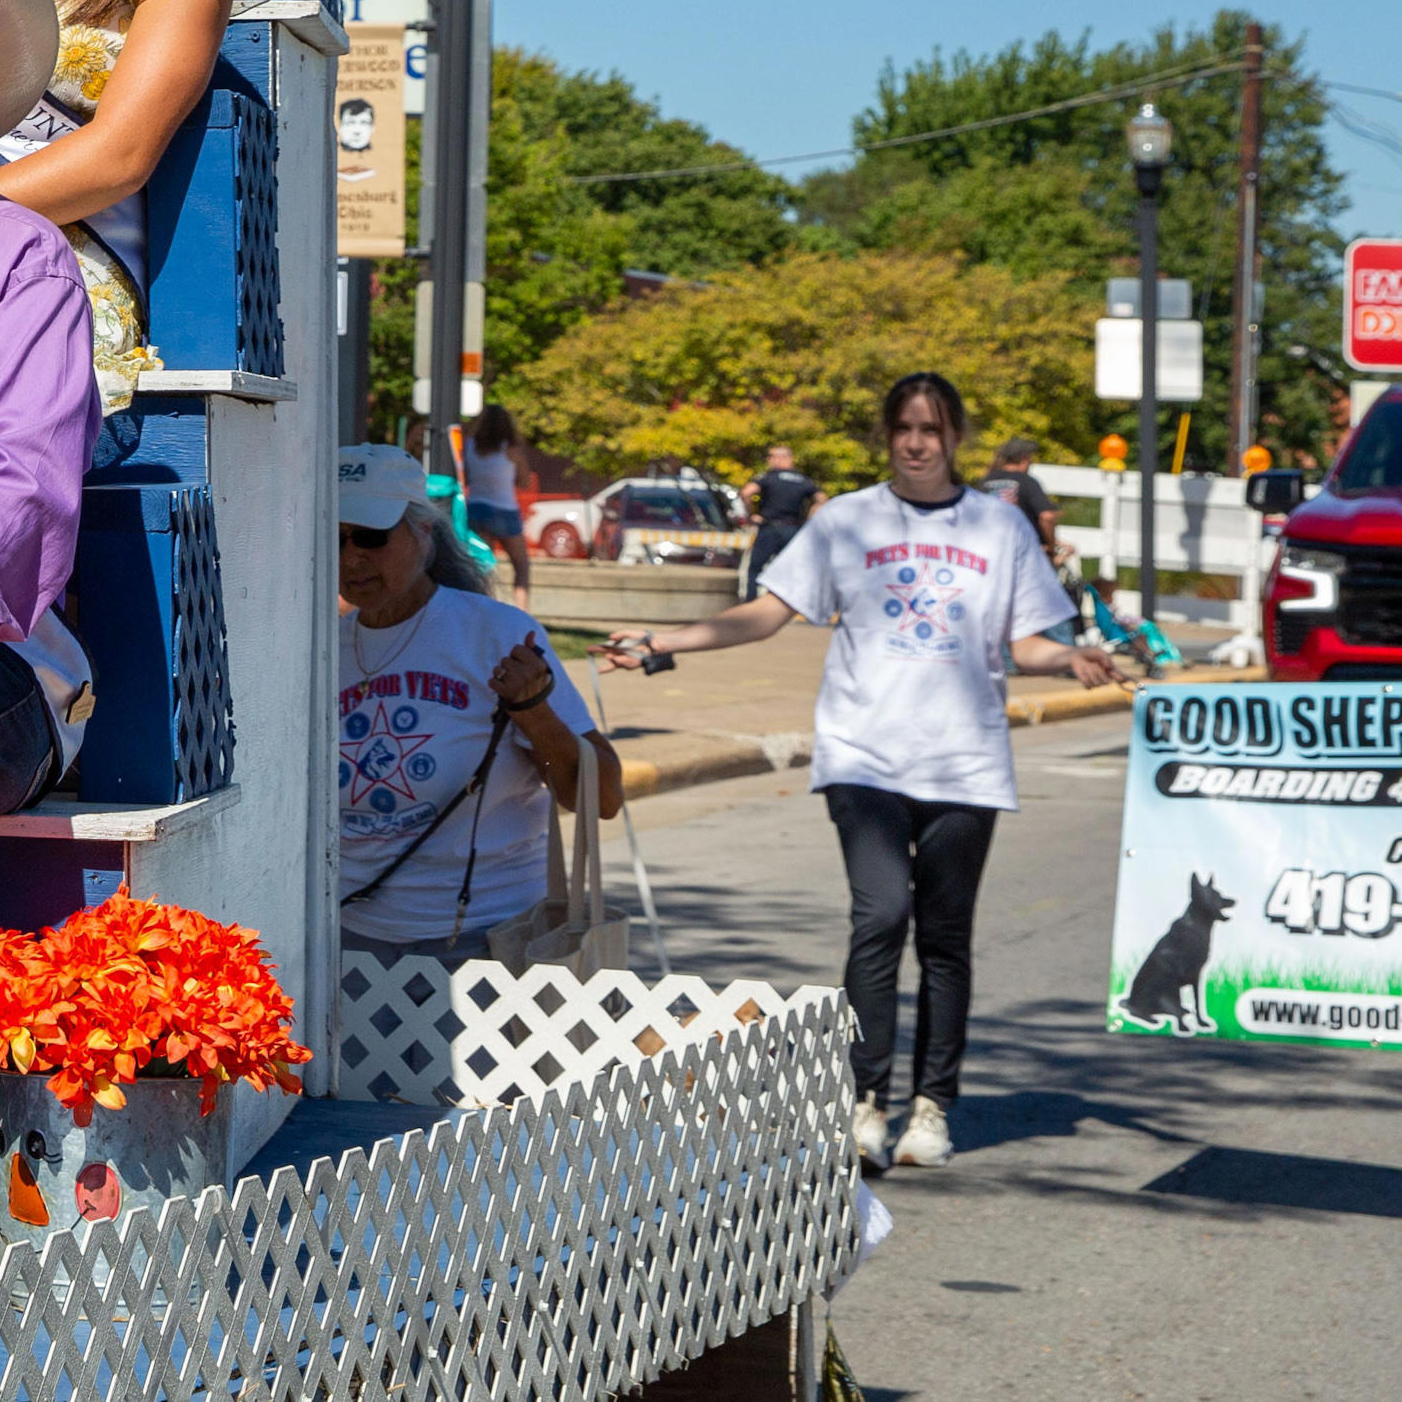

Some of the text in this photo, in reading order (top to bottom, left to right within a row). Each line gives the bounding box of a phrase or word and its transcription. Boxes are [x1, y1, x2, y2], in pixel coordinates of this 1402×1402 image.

[338, 462, 366, 477] SA
[865, 542, 988, 576] PETS FOR VETS
[367, 673, 401, 698] FOR
[404, 670, 471, 711] VETS
[1145, 696, 1279, 752] GOOD
[1168, 765, 1384, 803] BOARDING
